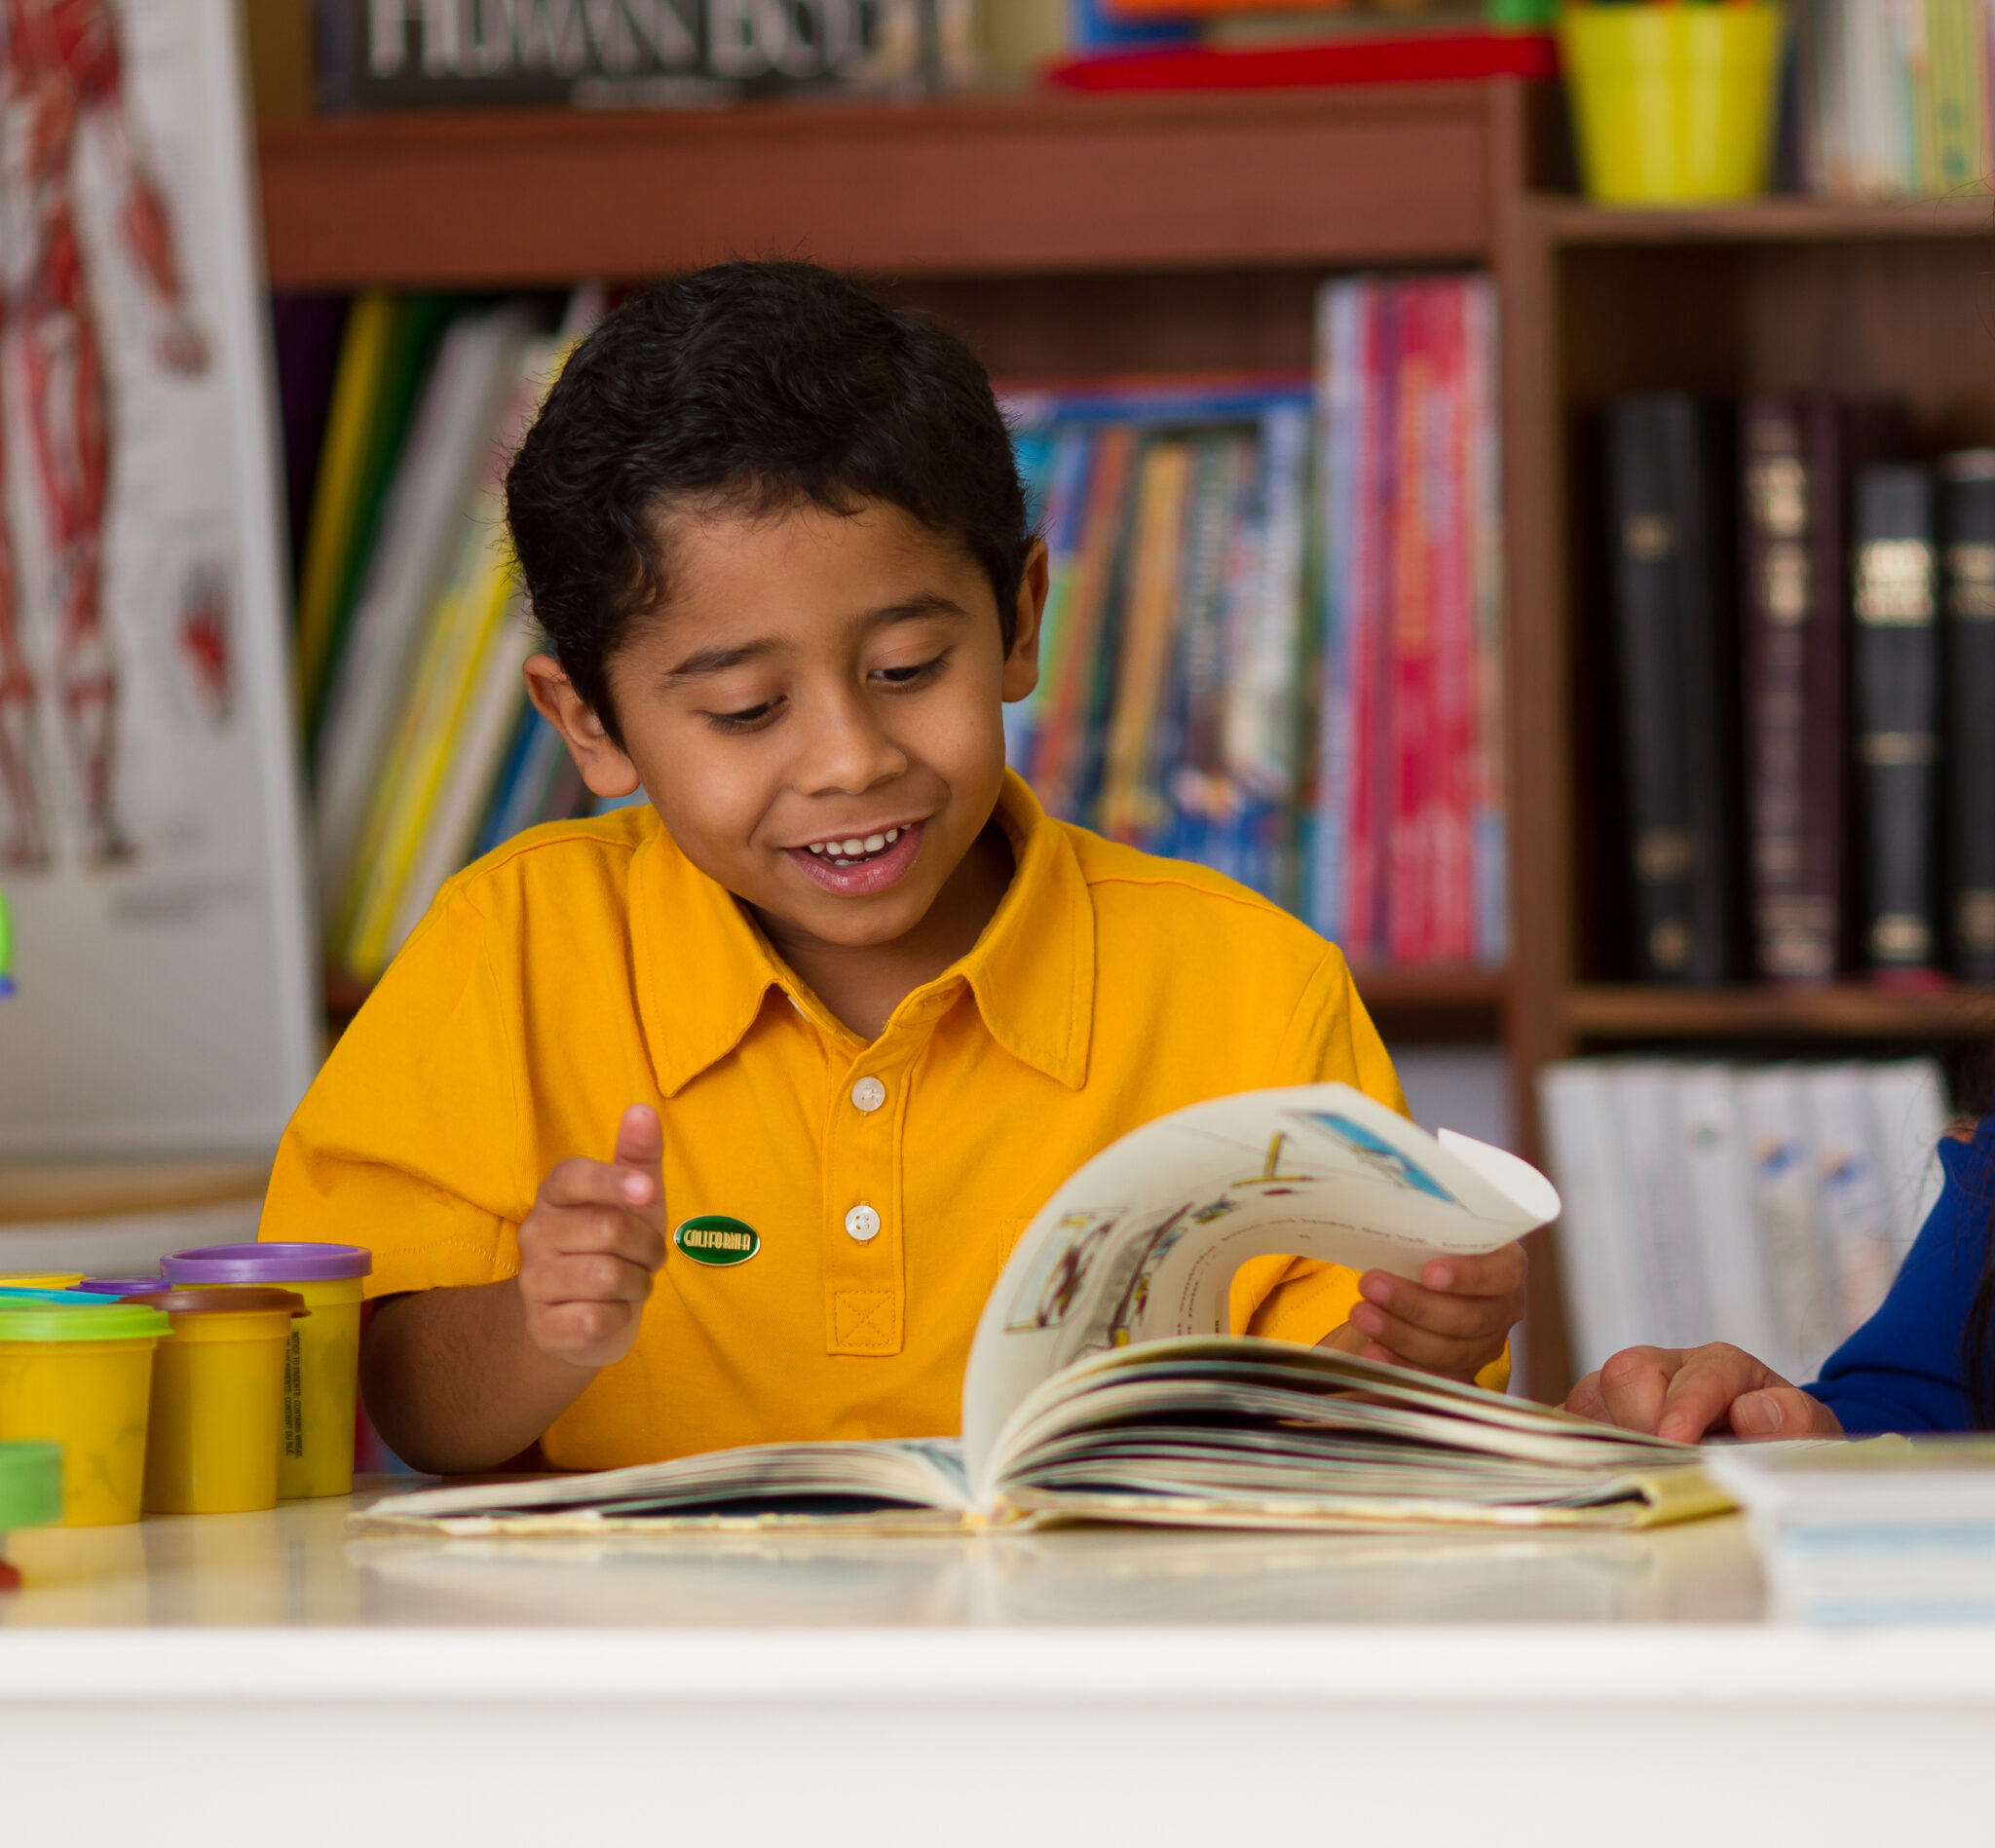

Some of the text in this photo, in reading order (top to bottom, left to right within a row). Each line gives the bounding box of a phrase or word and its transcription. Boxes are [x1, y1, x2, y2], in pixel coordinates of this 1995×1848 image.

[683, 1228, 751, 1252] CALIFORNIA
[291, 1331, 300, 1353] NOTICE
[292, 1355, 300, 1365] TO
